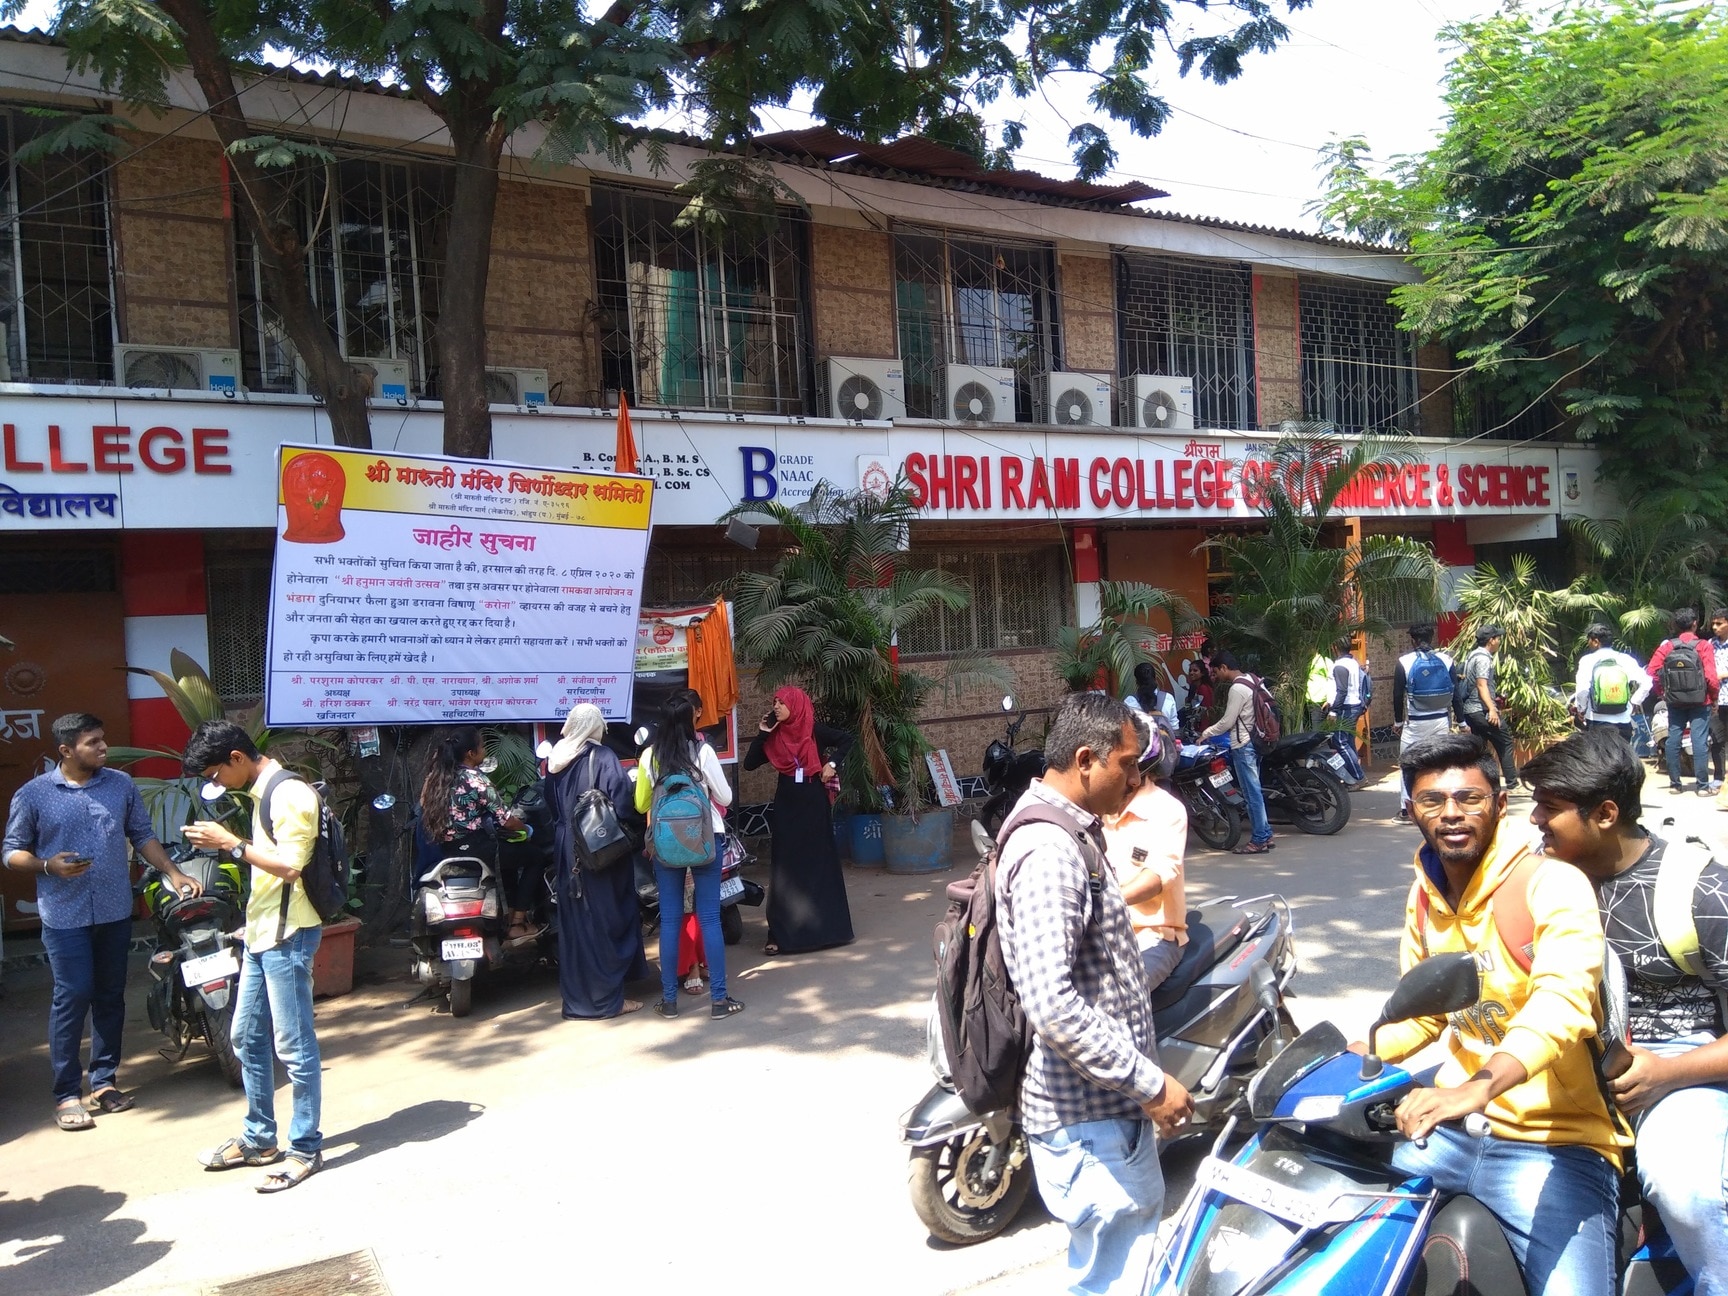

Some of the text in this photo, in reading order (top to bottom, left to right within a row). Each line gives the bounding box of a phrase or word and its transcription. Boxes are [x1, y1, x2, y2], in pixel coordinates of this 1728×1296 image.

[662, 454, 674, 462] B.
[676, 454, 690, 462] M.
[780, 456, 814, 464] GRADE
[663, 468, 710, 476] B. Sc. CS
[738, 446, 778, 501] B
[780, 470, 814, 482] NAAC
[365, 460, 392, 483] श्री
[461, 468, 503, 493] मंदिर
[593, 481, 645, 504] समिती
[664, 481, 690, 490] COM
[904, 452, 992, 510] SHRI
[1000, 456, 1081, 510] RAM
[1089, 457, 1235, 509] COLLEGE
[1436, 464, 1454, 506] &
[1458, 464, 1551, 506] SCIENCE
[413, 524, 536, 555] जाहीर सुचना
[314, 554, 335, 566] सभी
[379, 558, 406, 570] सुचित
[408, 559, 432, 570] किया
[434, 562, 454, 572] जाता
[456, 560, 462, 572] है
[482, 564, 512, 574] हरसाल
[514, 564, 526, 574] की
[528, 567, 545, 577] तरह
[570, 566, 592, 579] एप्रिल
[624, 570, 635, 580] को
[286, 572, 328, 584] होनेवाला
[356, 576, 386, 589] हनुमान
[388, 577, 413, 588] जयंती
[448, 582, 464, 590] तथा
[466, 582, 480, 592] इस
[482, 582, 510, 592] अवसर
[512, 584, 524, 592] पर
[526, 582, 560, 594] होनेवाला
[561, 586, 592, 596] रामकथा
[594, 586, 625, 596] आयोजन
[286, 592, 316, 603] भंडारा
[318, 593, 361, 606] दुनियाभर
[364, 594, 388, 606] फैला
[390, 598, 410, 609] हुआ
[412, 598, 445, 608] डरावना
[520, 602, 550, 612] व्हायरस
[553, 602, 564, 612] की
[568, 604, 586, 613] वजह
[589, 602, 597, 612] से
[599, 603, 618, 613] बचने
[620, 604, 632, 616] हेतु
[285, 610, 305, 622] और
[306, 614, 332, 624] जनता
[334, 613, 348, 624] की
[350, 613, 371, 625] सेहत
[374, 616, 388, 624] का
[388, 616, 418, 626] खयाल
[420, 616, 441, 626] करते
[442, 618, 456, 628] हुए
[469, 619, 483, 627] कर
[484, 616, 504, 628] दिया
[310, 633, 331, 644] कृपा
[334, 632, 359, 643] करके
[361, 633, 386, 644] हमारी
[388, 634, 428, 644] भावनाओं
[430, 634, 442, 644] को
[444, 636, 464, 646] ध्यान
[474, 635, 496, 646] लेकर
[498, 635, 521, 647] हमारी
[523, 638, 553, 646] सहायता
[554, 636, 569, 646] करें
[576, 637, 593, 646] सभी
[594, 637, 615, 647] भक्तों
[616, 637, 628, 647] को
[284, 650, 427, 664] हो रही असुविधा के लिए हमें खेद है
[310, 677, 344, 686] परशुराम
[347, 675, 384, 685] कोपरकर
[497, 675, 521, 685] अशोक
[524, 674, 538, 684] शर्मा
[597, 676, 617, 686] पुजारी
[324, 690, 350, 698] अध्यक्ष
[451, 690, 480, 698] उपाध्यक्ष
[566, 687, 606, 695] सरचिटणीस
[320, 698, 342, 708] हरिश
[344, 700, 372, 708] ठक्कर
[448, 698, 471, 707] भावेश
[474, 698, 504, 708] परशुराम
[505, 697, 538, 706] कोपरकर
[316, 710, 356, 720] खजिनदार
[442, 709, 486, 718] सहचिटणीस
